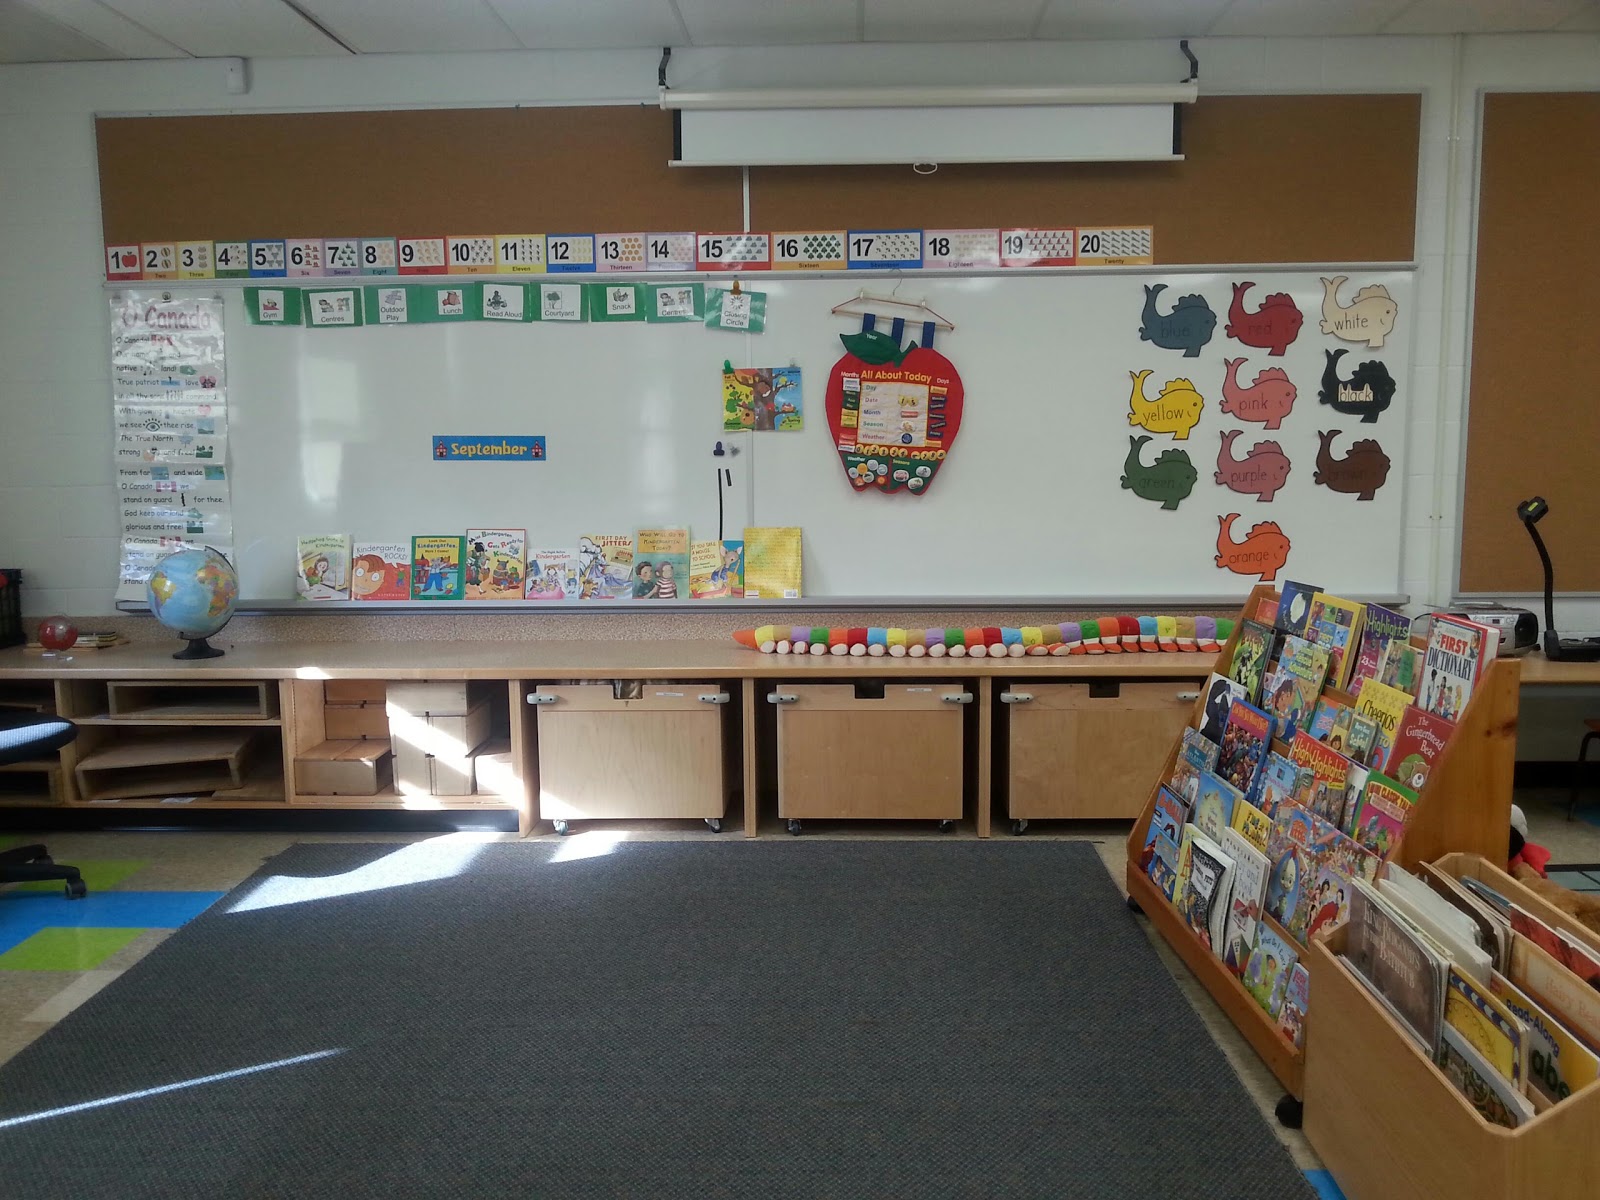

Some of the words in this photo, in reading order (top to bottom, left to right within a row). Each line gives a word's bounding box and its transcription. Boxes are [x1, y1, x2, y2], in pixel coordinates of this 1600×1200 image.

[451, 243, 470, 262] 10
[501, 242, 518, 261] 11
[551, 241, 569, 260] 12
[601, 241, 620, 260] 13
[651, 240, 670, 259] 14
[701, 239, 723, 259] 15
[776, 239, 799, 258] 16
[852, 238, 874, 257] 17
[928, 237, 950, 257] 18
[1004, 235, 1024, 255] 19
[1080, 234, 1100, 254] 20
[111, 251, 120, 269] 1
[146, 250, 158, 268] 2
[182, 249, 194, 267] 3
[218, 248, 231, 266] 4
[254, 248, 267, 266] 5
[291, 247, 303, 265] 6
[327, 246, 339, 264] 7
[365, 246, 377, 264] 8
[401, 244, 414, 263] 9
[145, 304, 211, 330] Canada
[262, 311, 278, 319] Gym
[386, 314, 400, 322] Play
[1334, 311, 1369, 331] white
[866, 333, 878, 341] Year
[1160, 321, 1191, 339] blue
[1247, 321, 1273, 337] red
[860, 370, 873, 379] All
[875, 370, 903, 380] About
[904, 371, 932, 384] Today
[936, 377, 950, 385] Days
[1338, 384, 1373, 402] black
[1239, 392, 1268, 413] pink
[1142, 404, 1184, 427] yellow
[118, 449, 141, 457] strong
[450, 440, 528, 458] September
[1230, 464, 1267, 489] purple
[1327, 463, 1367, 481] brown
[1138, 476, 1175, 491] green
[153, 496, 173, 504] guard
[139, 510, 155, 518] keep
[125, 524, 152, 532] glorious
[356, 545, 406, 553] Kindergarten
[1228, 551, 1269, 564] orange
[1366, 609, 1410, 638] Highlights
[1439, 634, 1469, 656] FIRST
[1360, 656, 1369, 666] 23
[1427, 646, 1474, 682] DICTIONARY
[1418, 716, 1429, 726] The
[1379, 736, 1390, 749] TO
[1405, 724, 1446, 752] Gingerbread
[1420, 739, 1435, 759] Bear
[1309, 749, 1347, 782] Highlights
[1506, 998, 1560, 1059] Read-Along
